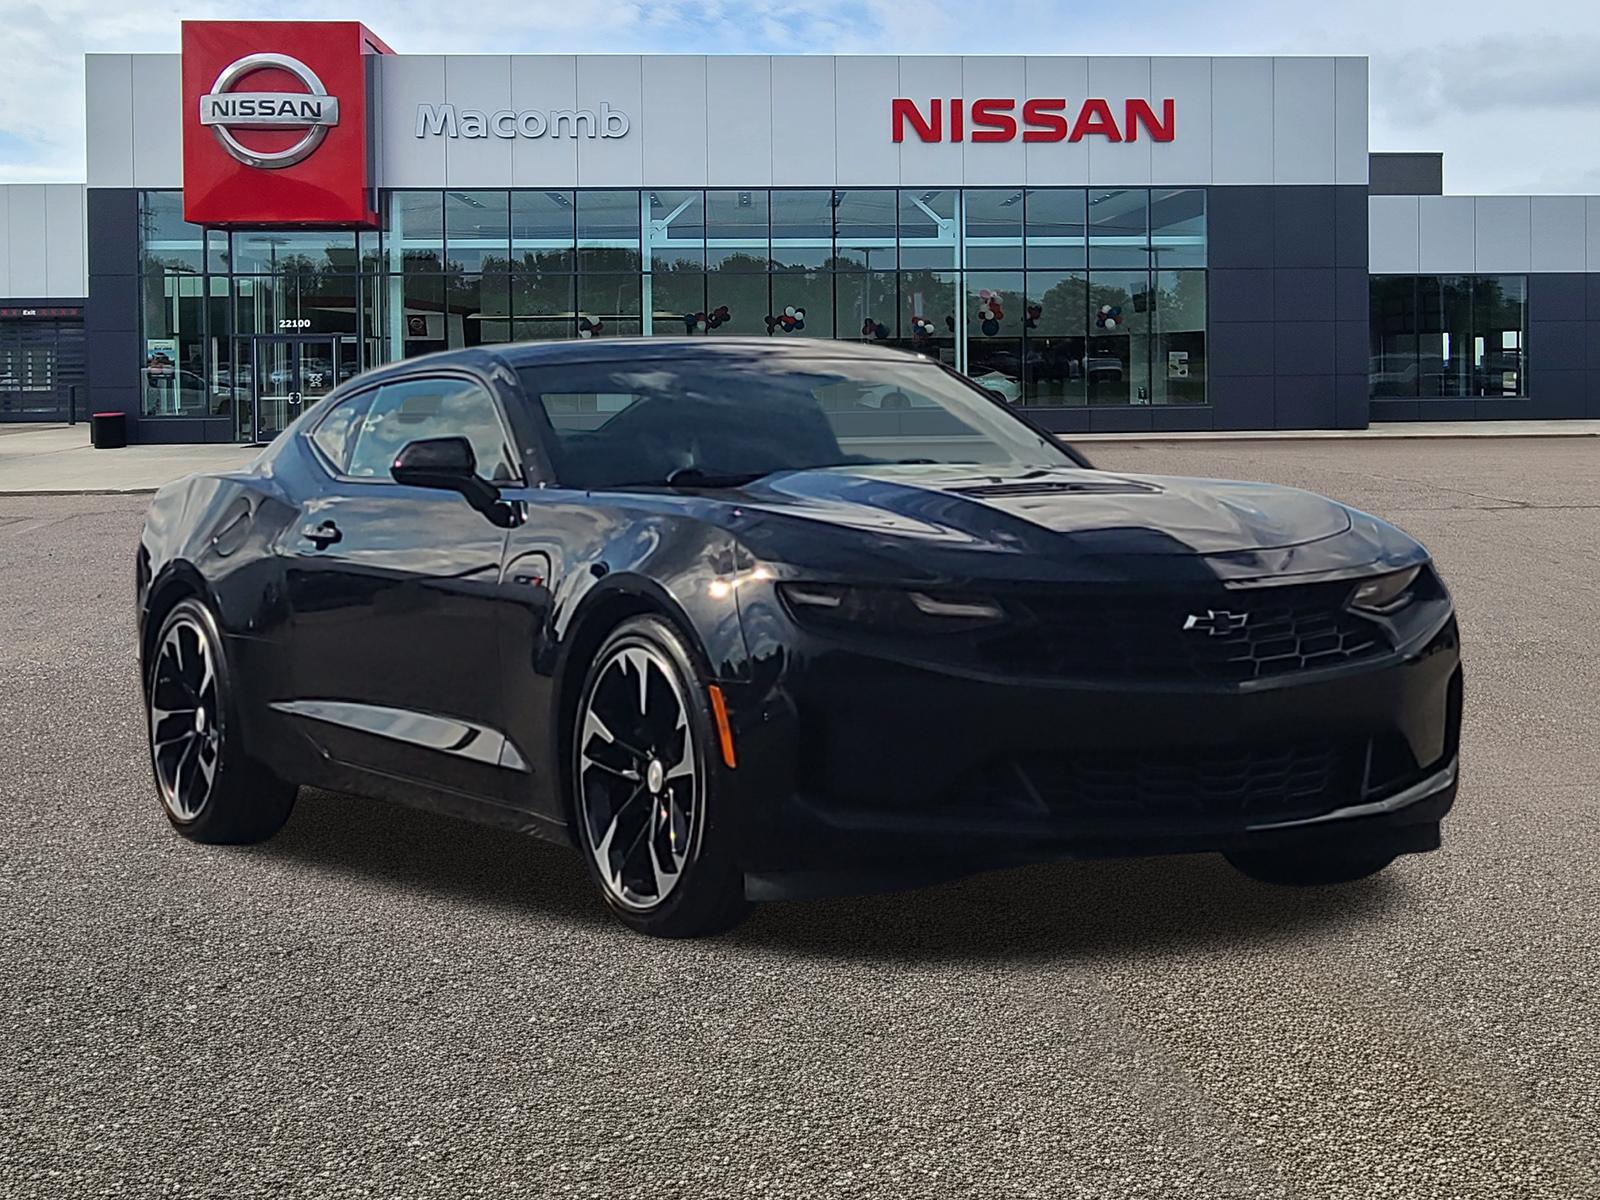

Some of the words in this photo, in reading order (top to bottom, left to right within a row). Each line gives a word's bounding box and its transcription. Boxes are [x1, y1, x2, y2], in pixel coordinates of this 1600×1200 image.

[211, 100, 322, 118] NISSAN
[415, 102, 630, 139] Macomb
[892, 98, 1175, 143] NISSAN
[279, 319, 311, 328] 22100
